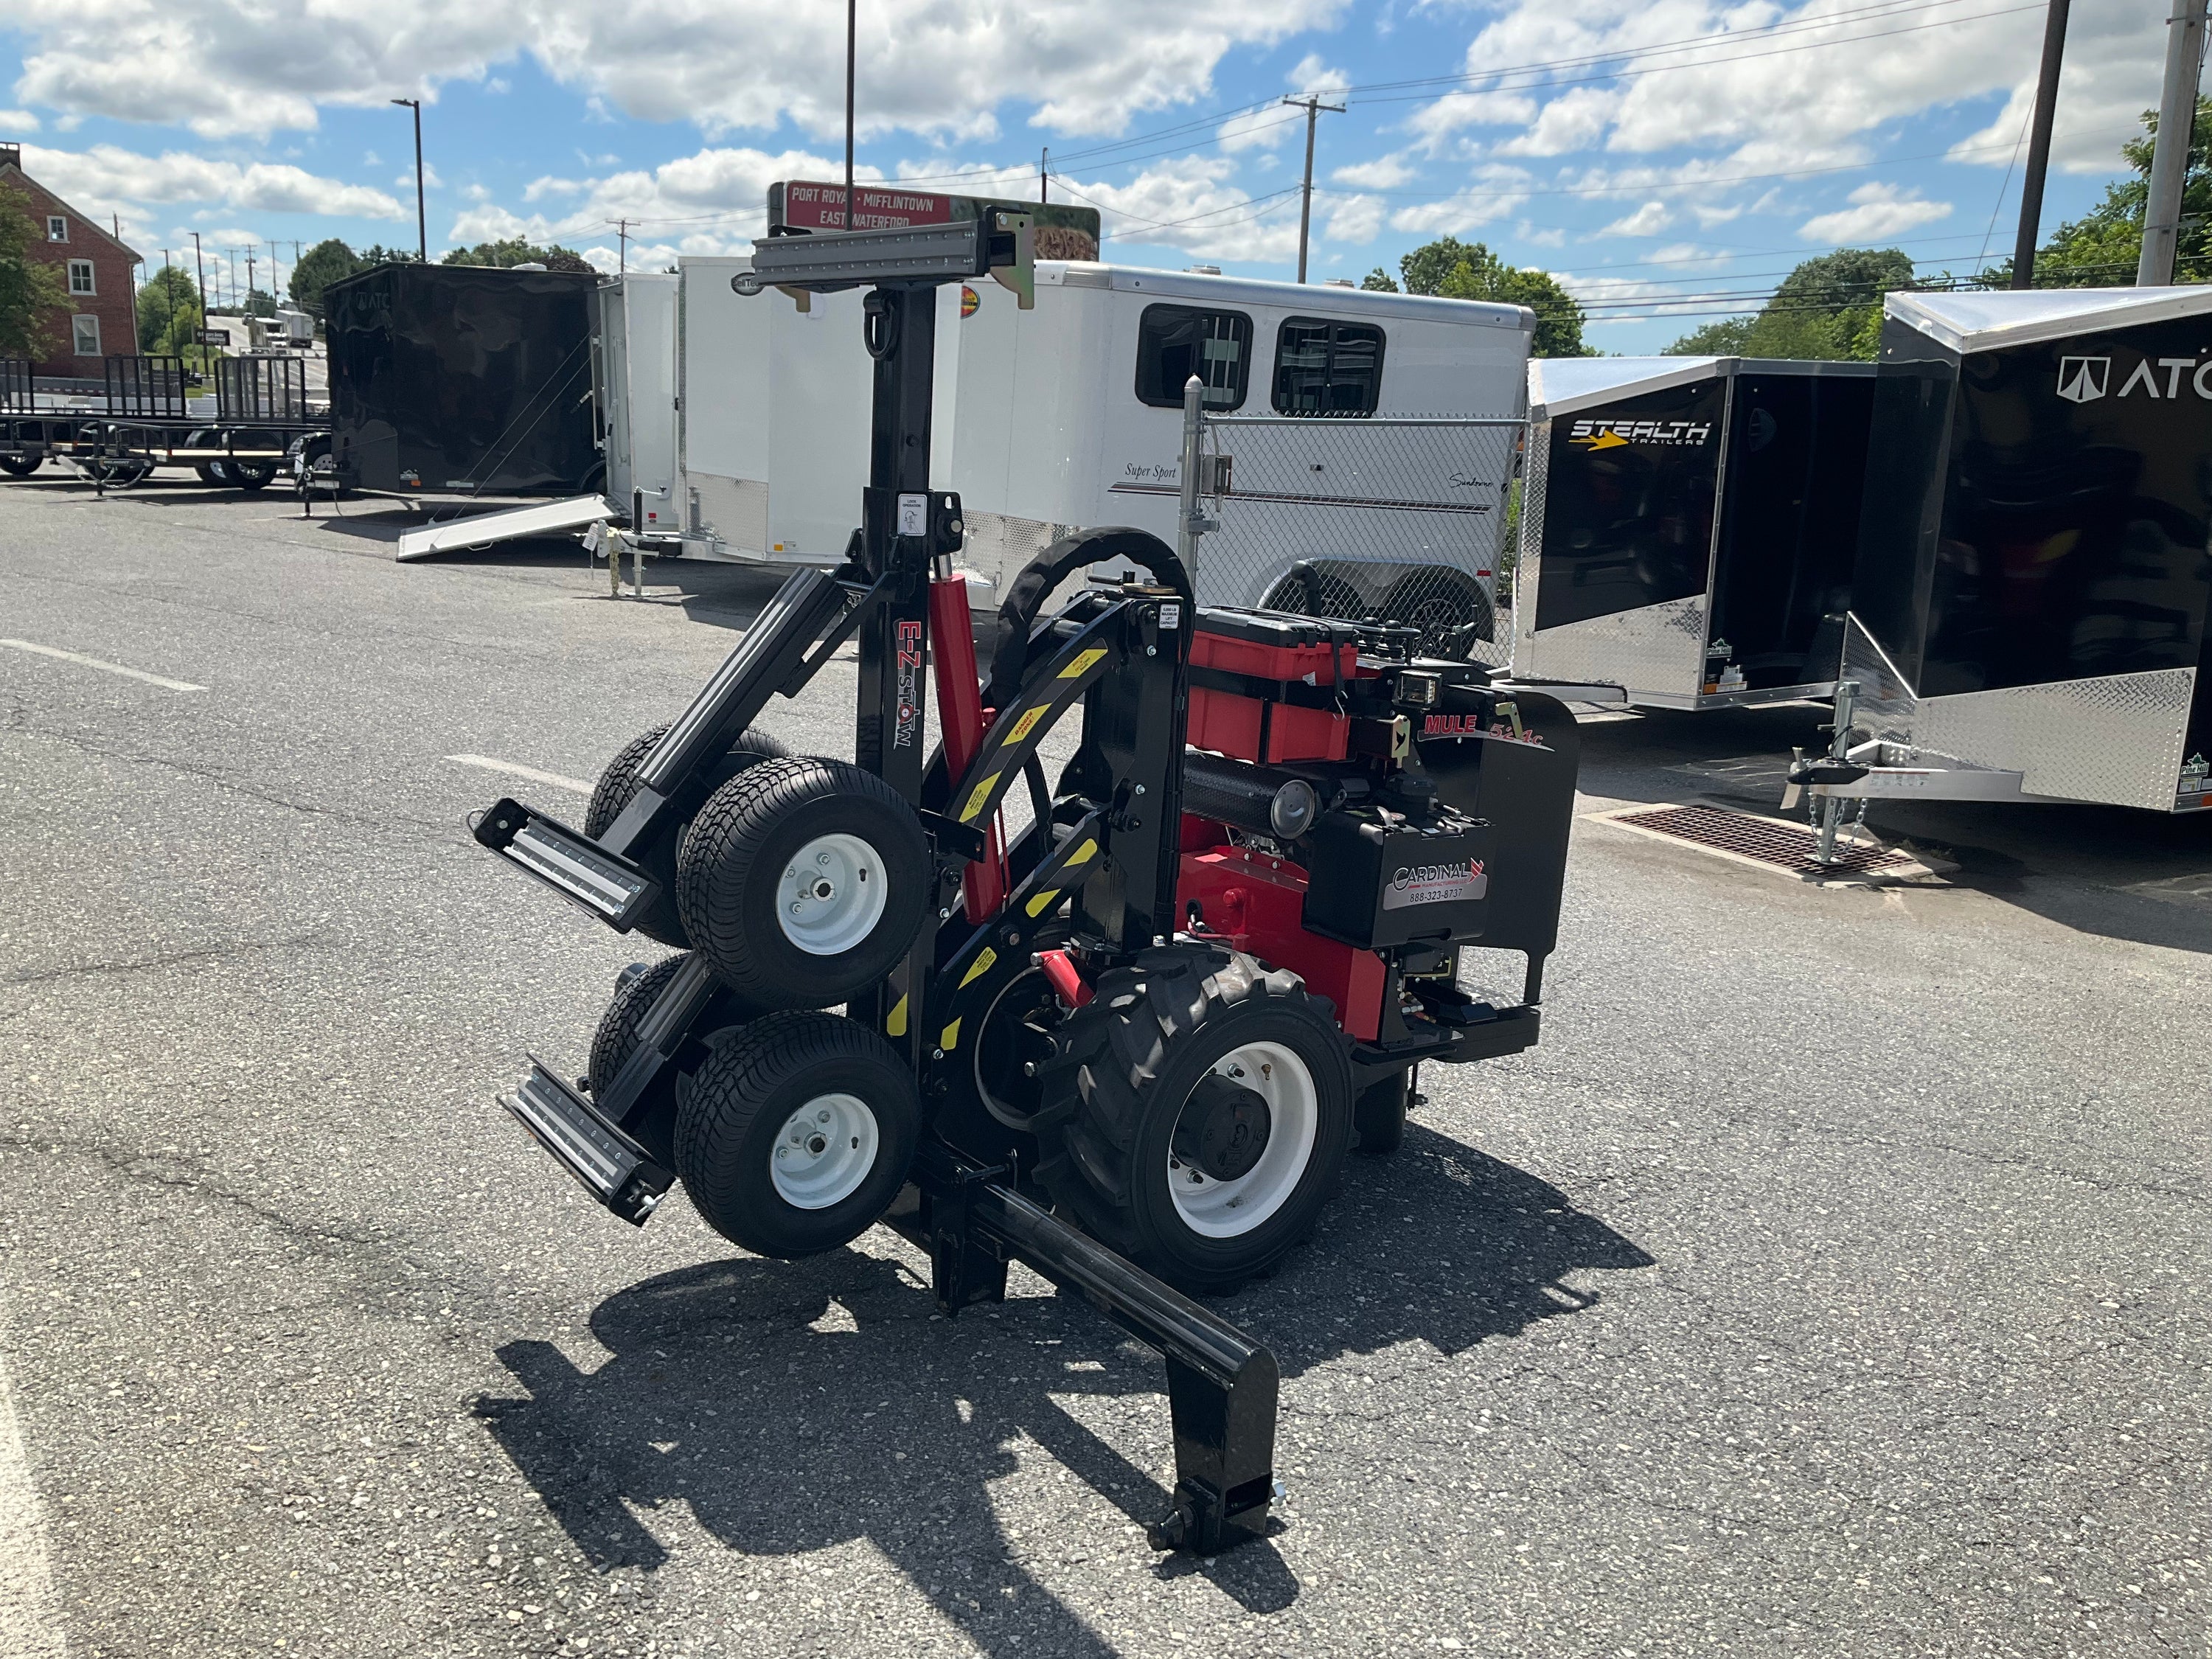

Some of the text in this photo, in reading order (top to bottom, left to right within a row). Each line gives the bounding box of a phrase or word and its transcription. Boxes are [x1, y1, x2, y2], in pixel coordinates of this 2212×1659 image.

[792, 187, 934, 212] PORT ROYA MIFFLINTOWN
[820, 211, 846, 226] EAST
[1571, 420, 1711, 439] STEALTH
[1125, 462, 1176, 481] Super Sport
[898, 621, 922, 669] E-Z
[1424, 714, 1478, 734] MULE
[2197, 762, 2208, 772] Hill
[1393, 862, 1469, 891] CARDINAL
[1410, 888, 1463, 902] 888-323-8737
